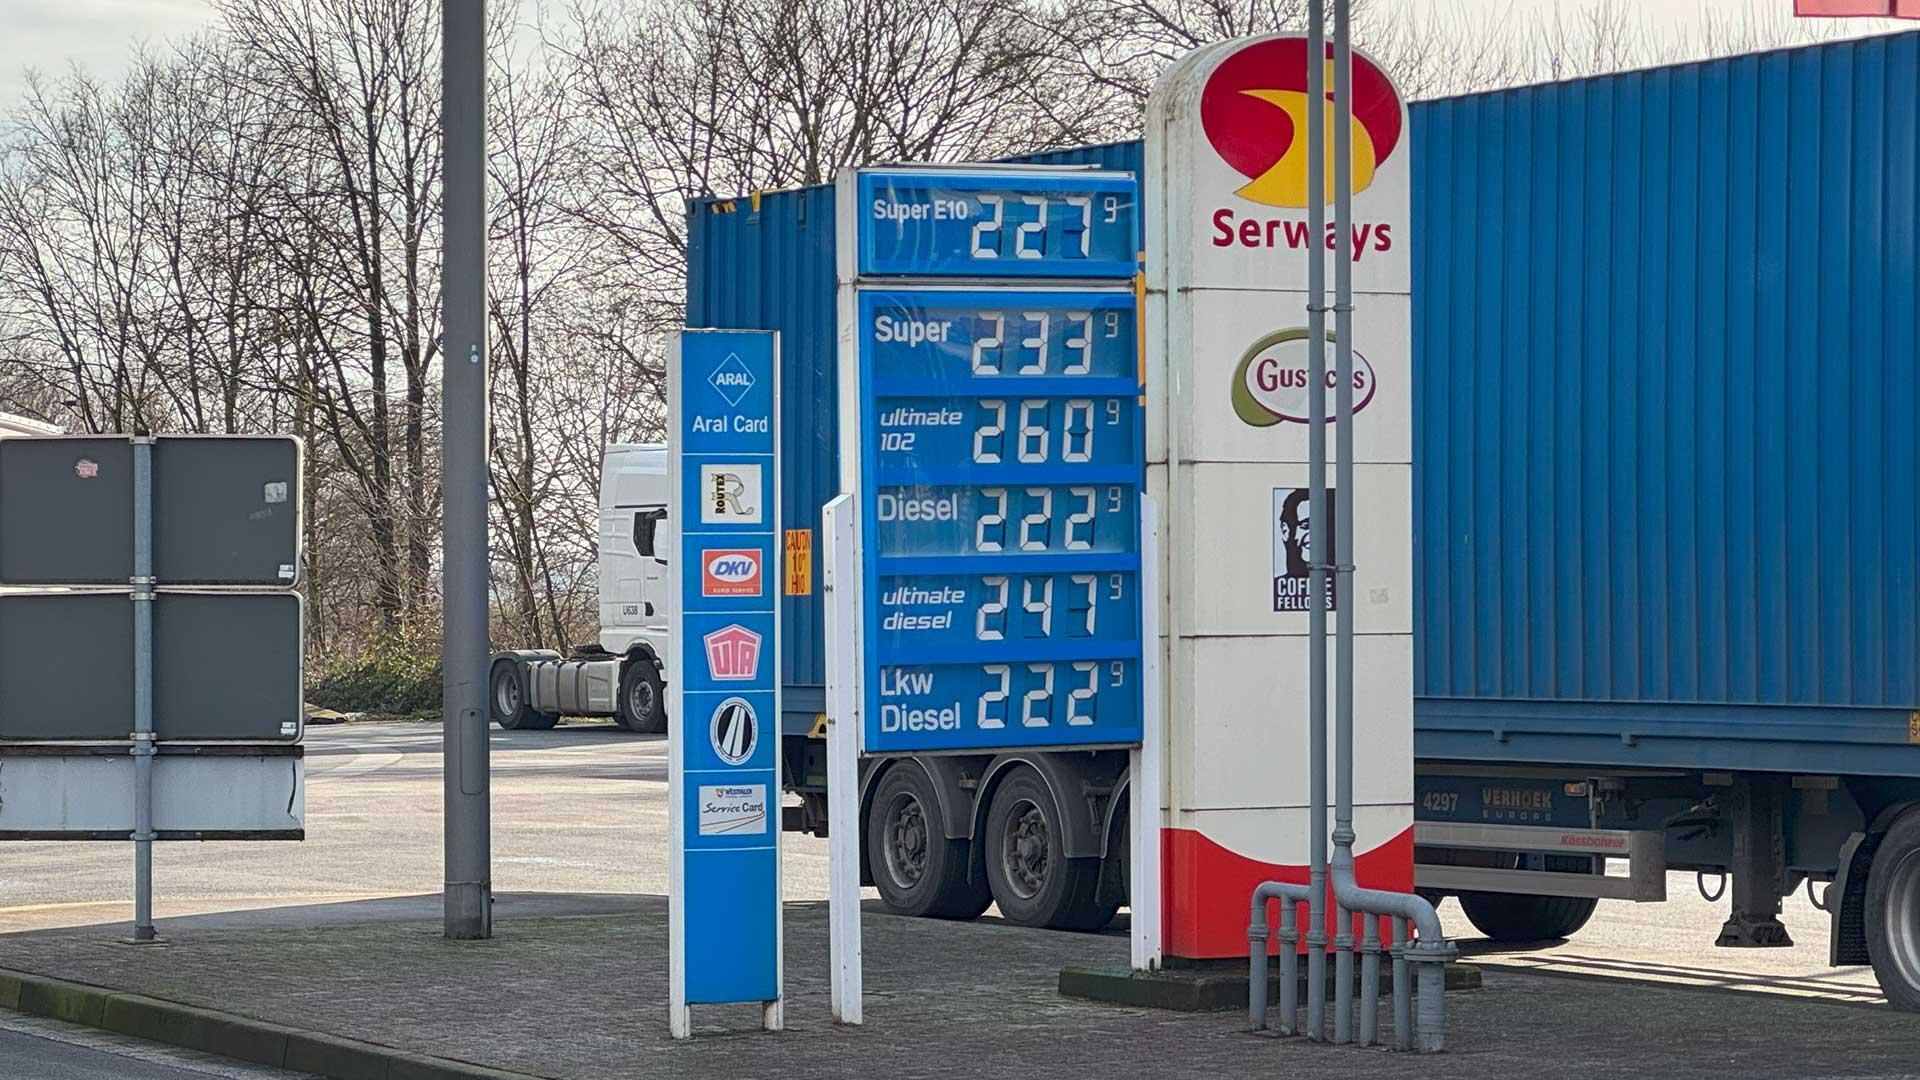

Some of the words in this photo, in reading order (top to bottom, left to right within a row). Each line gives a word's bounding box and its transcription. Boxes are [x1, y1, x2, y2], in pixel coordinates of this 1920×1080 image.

[874, 199, 930, 225] Super
[935, 200, 968, 220] E10
[971, 195, 1091, 259] 227
[1104, 197, 1117, 223] 9
[875, 316, 951, 347] Super
[972, 311, 1093, 376] 233
[1106, 313, 1118, 338] 9
[716, 374, 750, 385] ARAL
[1258, 359, 1364, 392] Guscs
[693, 415, 727, 432] Aral
[734, 416, 768, 433] Card
[880, 408, 963, 425] ultimate
[881, 433, 914, 451] 102
[972, 399, 1094, 463] 260
[1107, 399, 1120, 425] 9
[715, 475, 725, 514] ROUTEX
[879, 493, 957, 521] Diesel
[975, 487, 1096, 552] 222
[1108, 486, 1121, 513] 9
[715, 561, 752, 575] DKV
[883, 587, 965, 605] ultimate
[1278, 578, 1332, 596] COFE
[976, 575, 1098, 640] 247
[1110, 574, 1122, 600] 9
[1278, 597, 1332, 609] FELLOS
[883, 611, 952, 630] diesel
[712, 642, 753, 675] UTA
[881, 669, 933, 696] Lkw
[978, 664, 1098, 728] 222
[1110, 661, 1123, 687] 9
[882, 702, 960, 732] Diesel
[703, 803, 740, 813] Service
[742, 803, 763, 812] Card
[1423, 792, 1458, 811] 4297
[1482, 788, 1552, 808] VERHOEK
[1483, 810, 1552, 821] EUROPE
